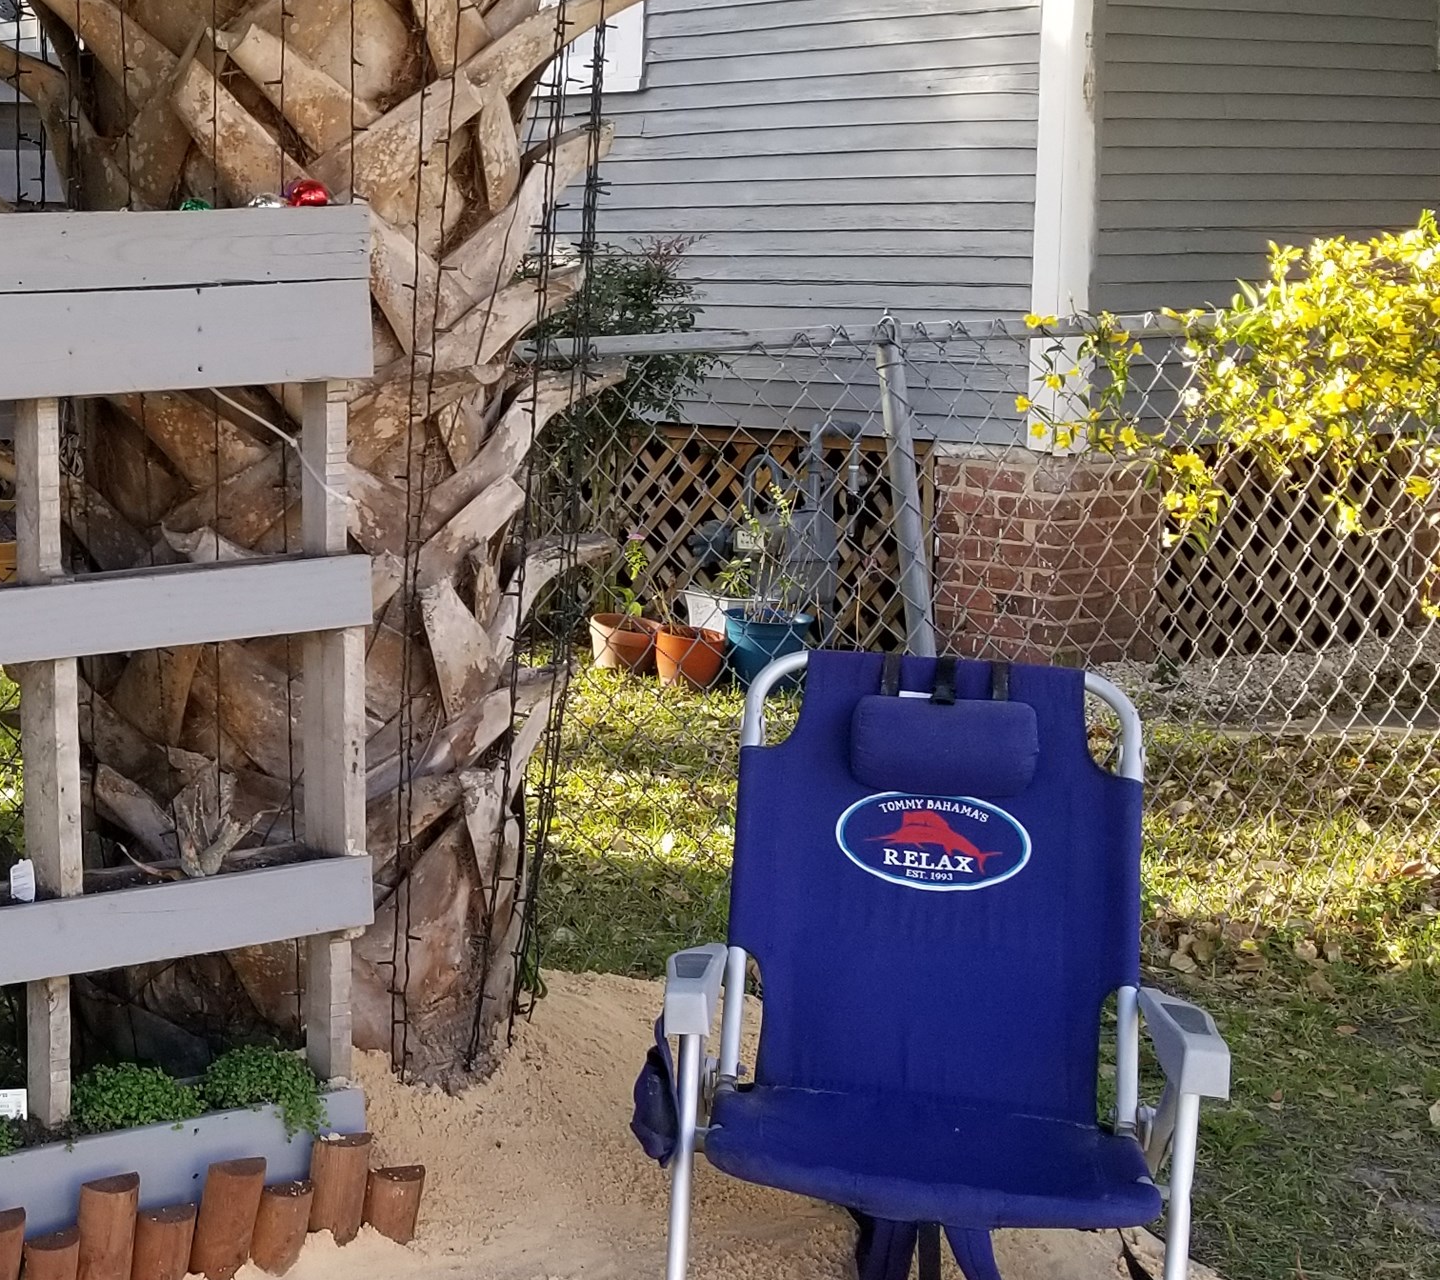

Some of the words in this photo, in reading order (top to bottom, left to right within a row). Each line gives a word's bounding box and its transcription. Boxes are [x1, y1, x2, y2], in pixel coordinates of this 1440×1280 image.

[878, 799, 924, 813] TOMMY
[926, 799, 989, 823] BAHAMA'S
[883, 848, 974, 873] RELAX
[905, 869, 928, 880] EST.
[930, 872, 953, 881] 1993
